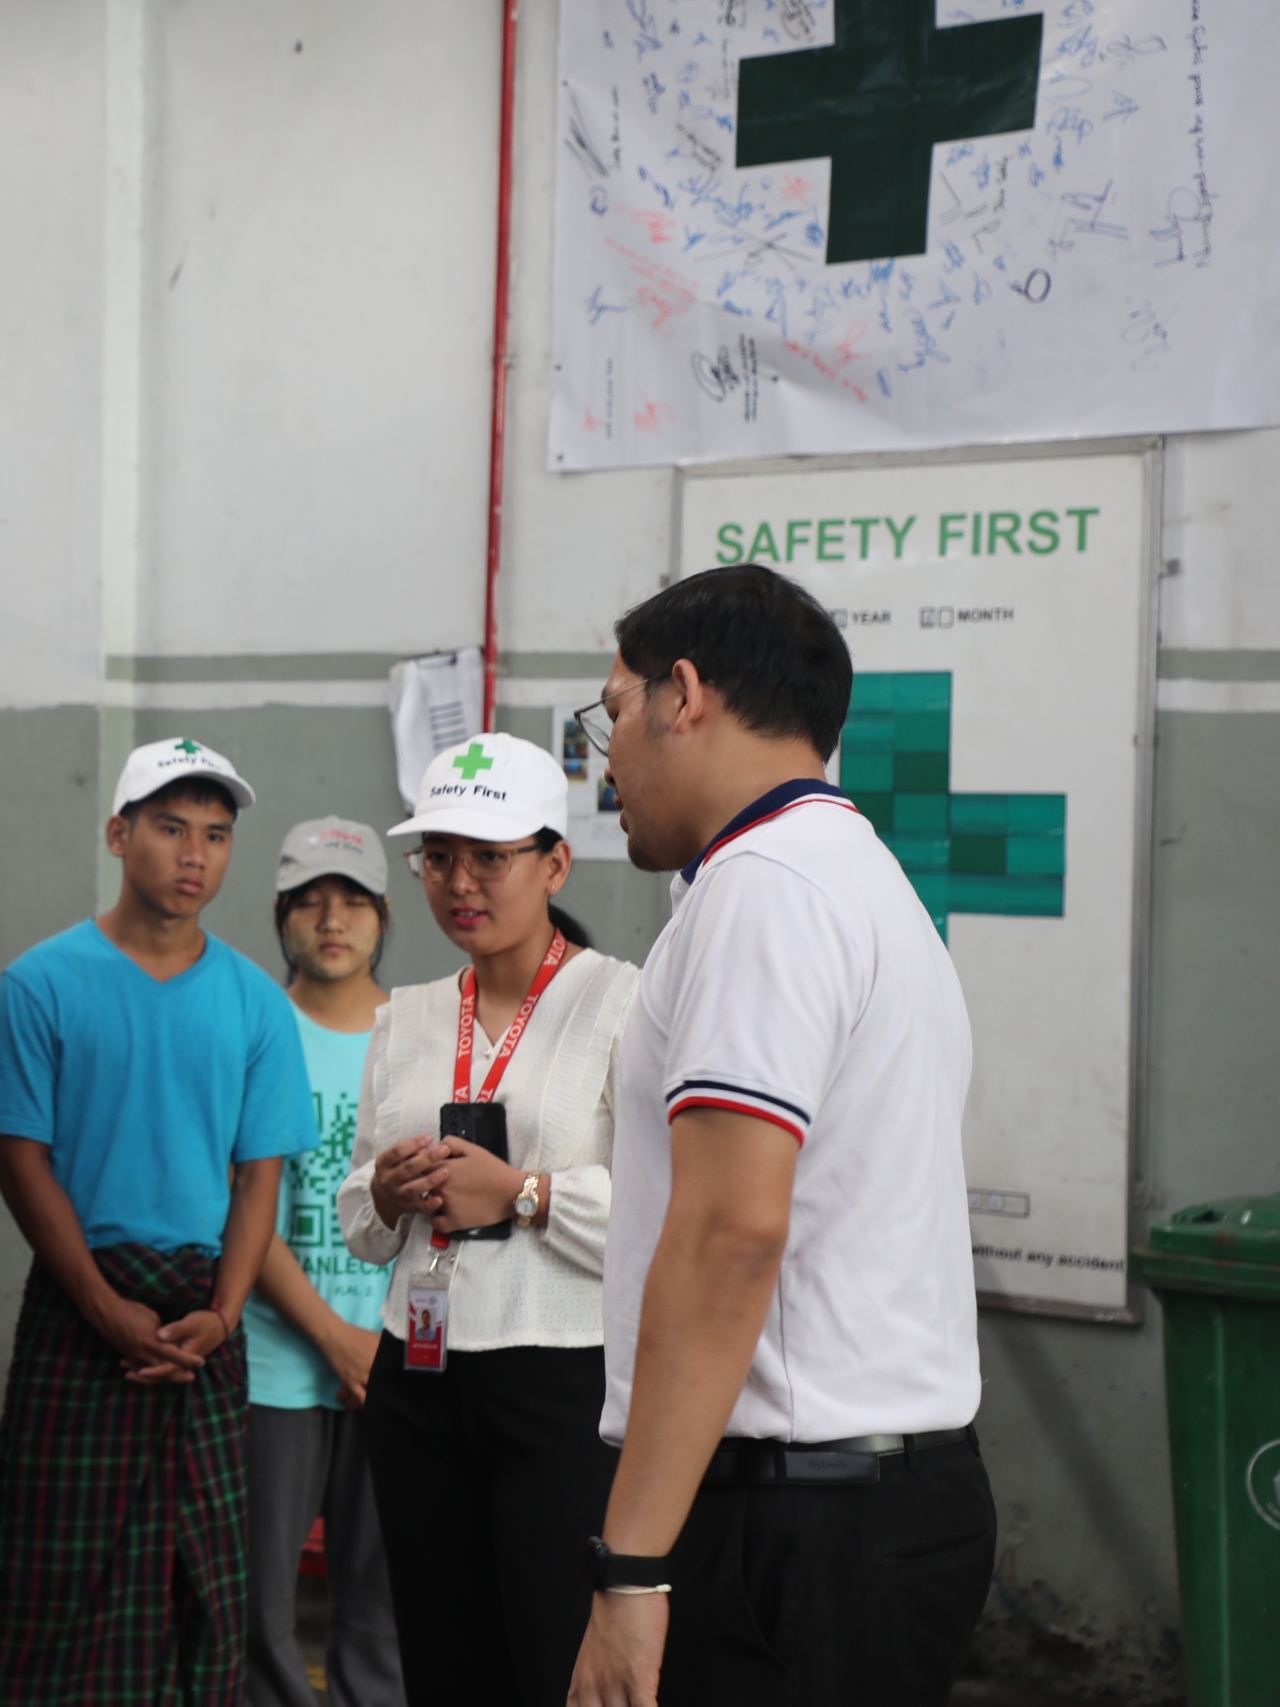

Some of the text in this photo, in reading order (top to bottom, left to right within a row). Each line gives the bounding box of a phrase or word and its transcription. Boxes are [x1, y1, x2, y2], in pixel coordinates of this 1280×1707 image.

[716, 507, 1100, 565] SAFETY FIRST
[852, 607, 1015, 625] YEAR MONTH
[430, 783, 507, 801] Safety First
[457, 994, 475, 1059] TOYOTA
[498, 994, 539, 1058] TOYOTA
[1027, 1251, 1054, 1270] any
[1059, 1254, 1124, 1273] accident
